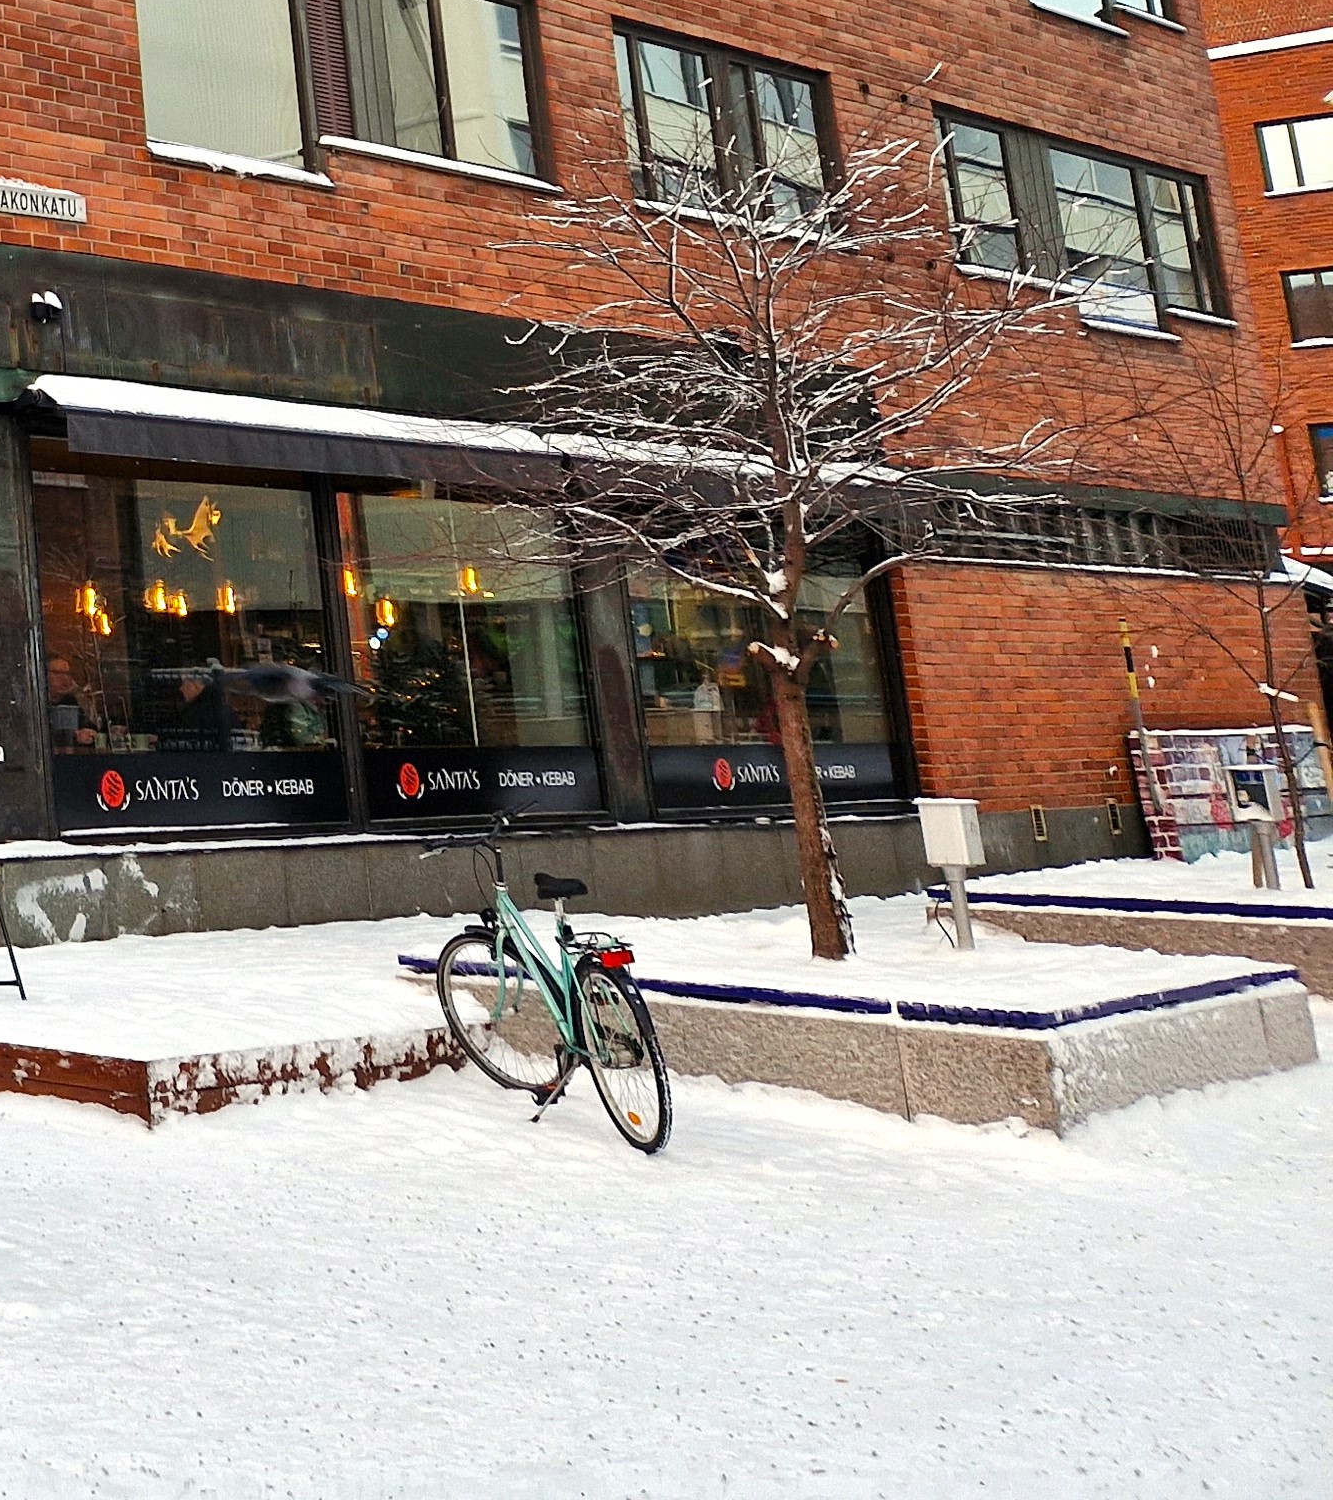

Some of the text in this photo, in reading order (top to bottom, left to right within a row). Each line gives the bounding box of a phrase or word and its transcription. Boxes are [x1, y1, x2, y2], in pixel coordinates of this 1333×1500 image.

[428, 768, 576, 791] SANTA'S DÖNER KEBAB
[737, 763, 780, 783] SANTA'S
[828, 765, 856, 779] KEBAB
[135, 777, 314, 801] SANTA'S DÖNER KEBAB
